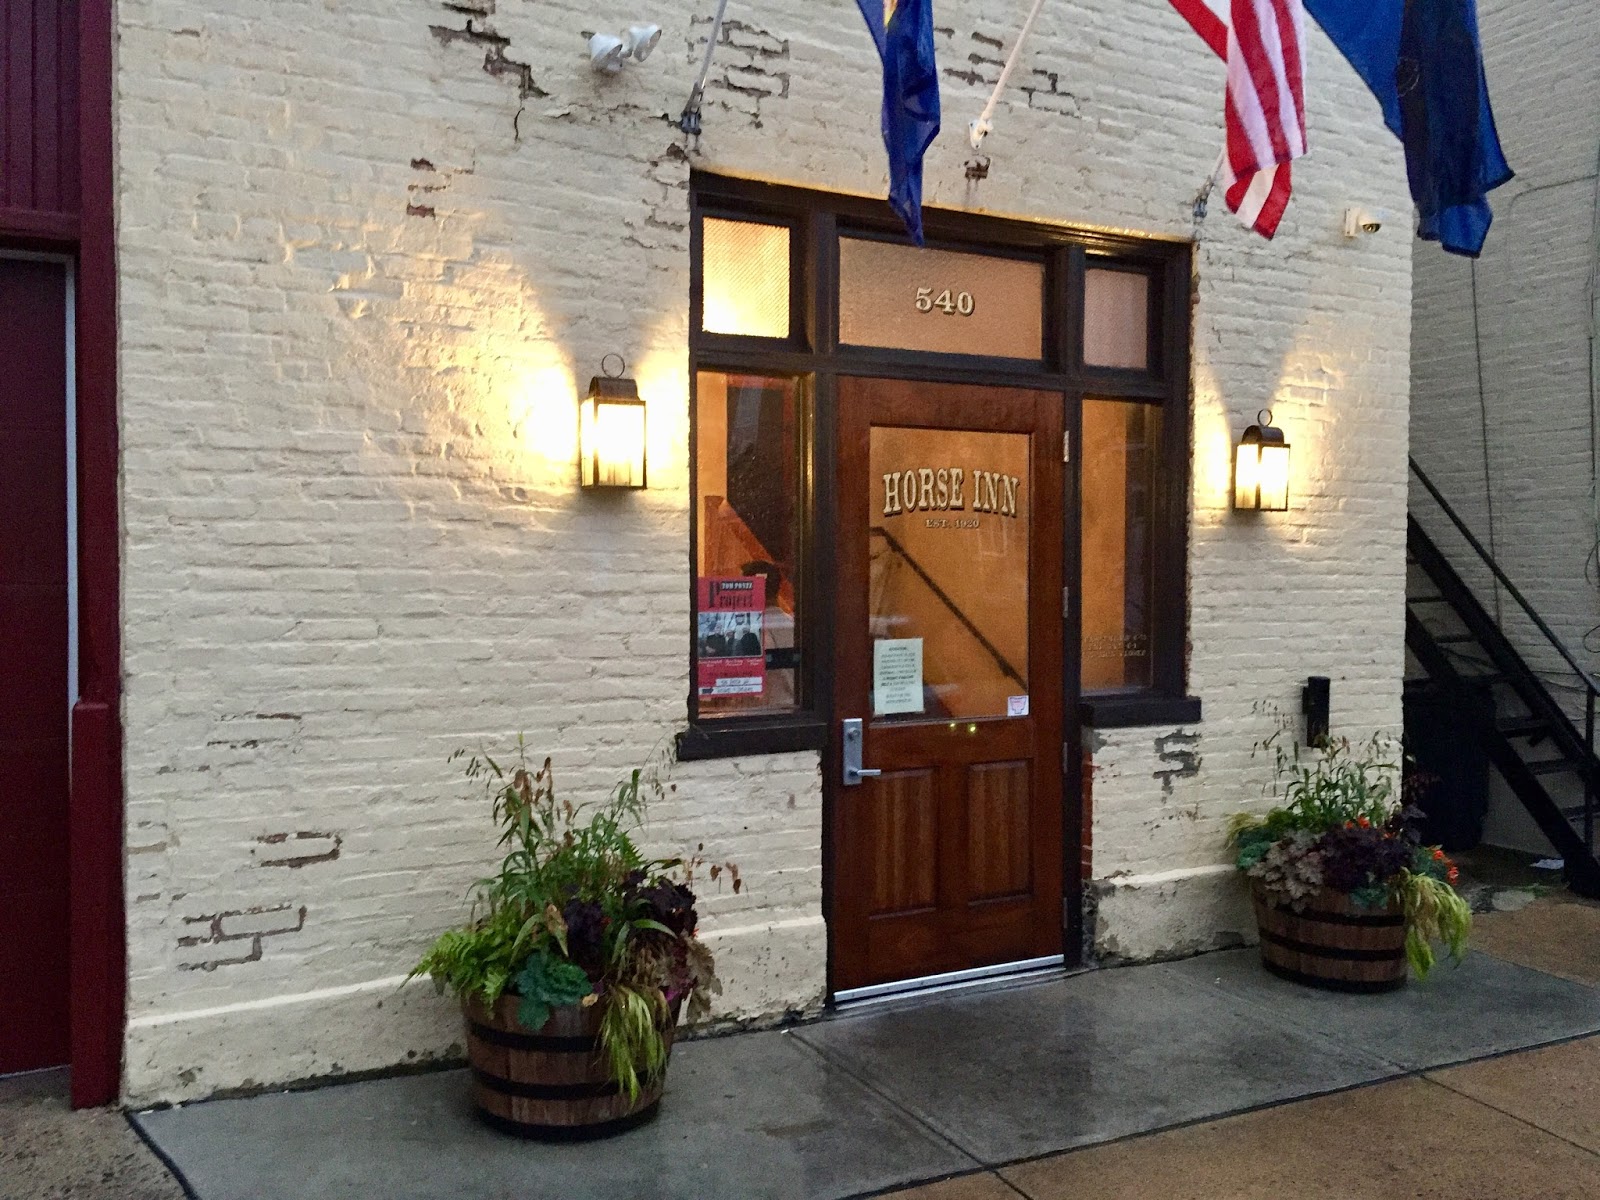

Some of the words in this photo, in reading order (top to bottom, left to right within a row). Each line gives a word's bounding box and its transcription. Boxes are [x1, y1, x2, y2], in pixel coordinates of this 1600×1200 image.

[915, 286, 975, 316] 540
[883, 467, 965, 516] HORSE
[972, 470, 1019, 517] INN
